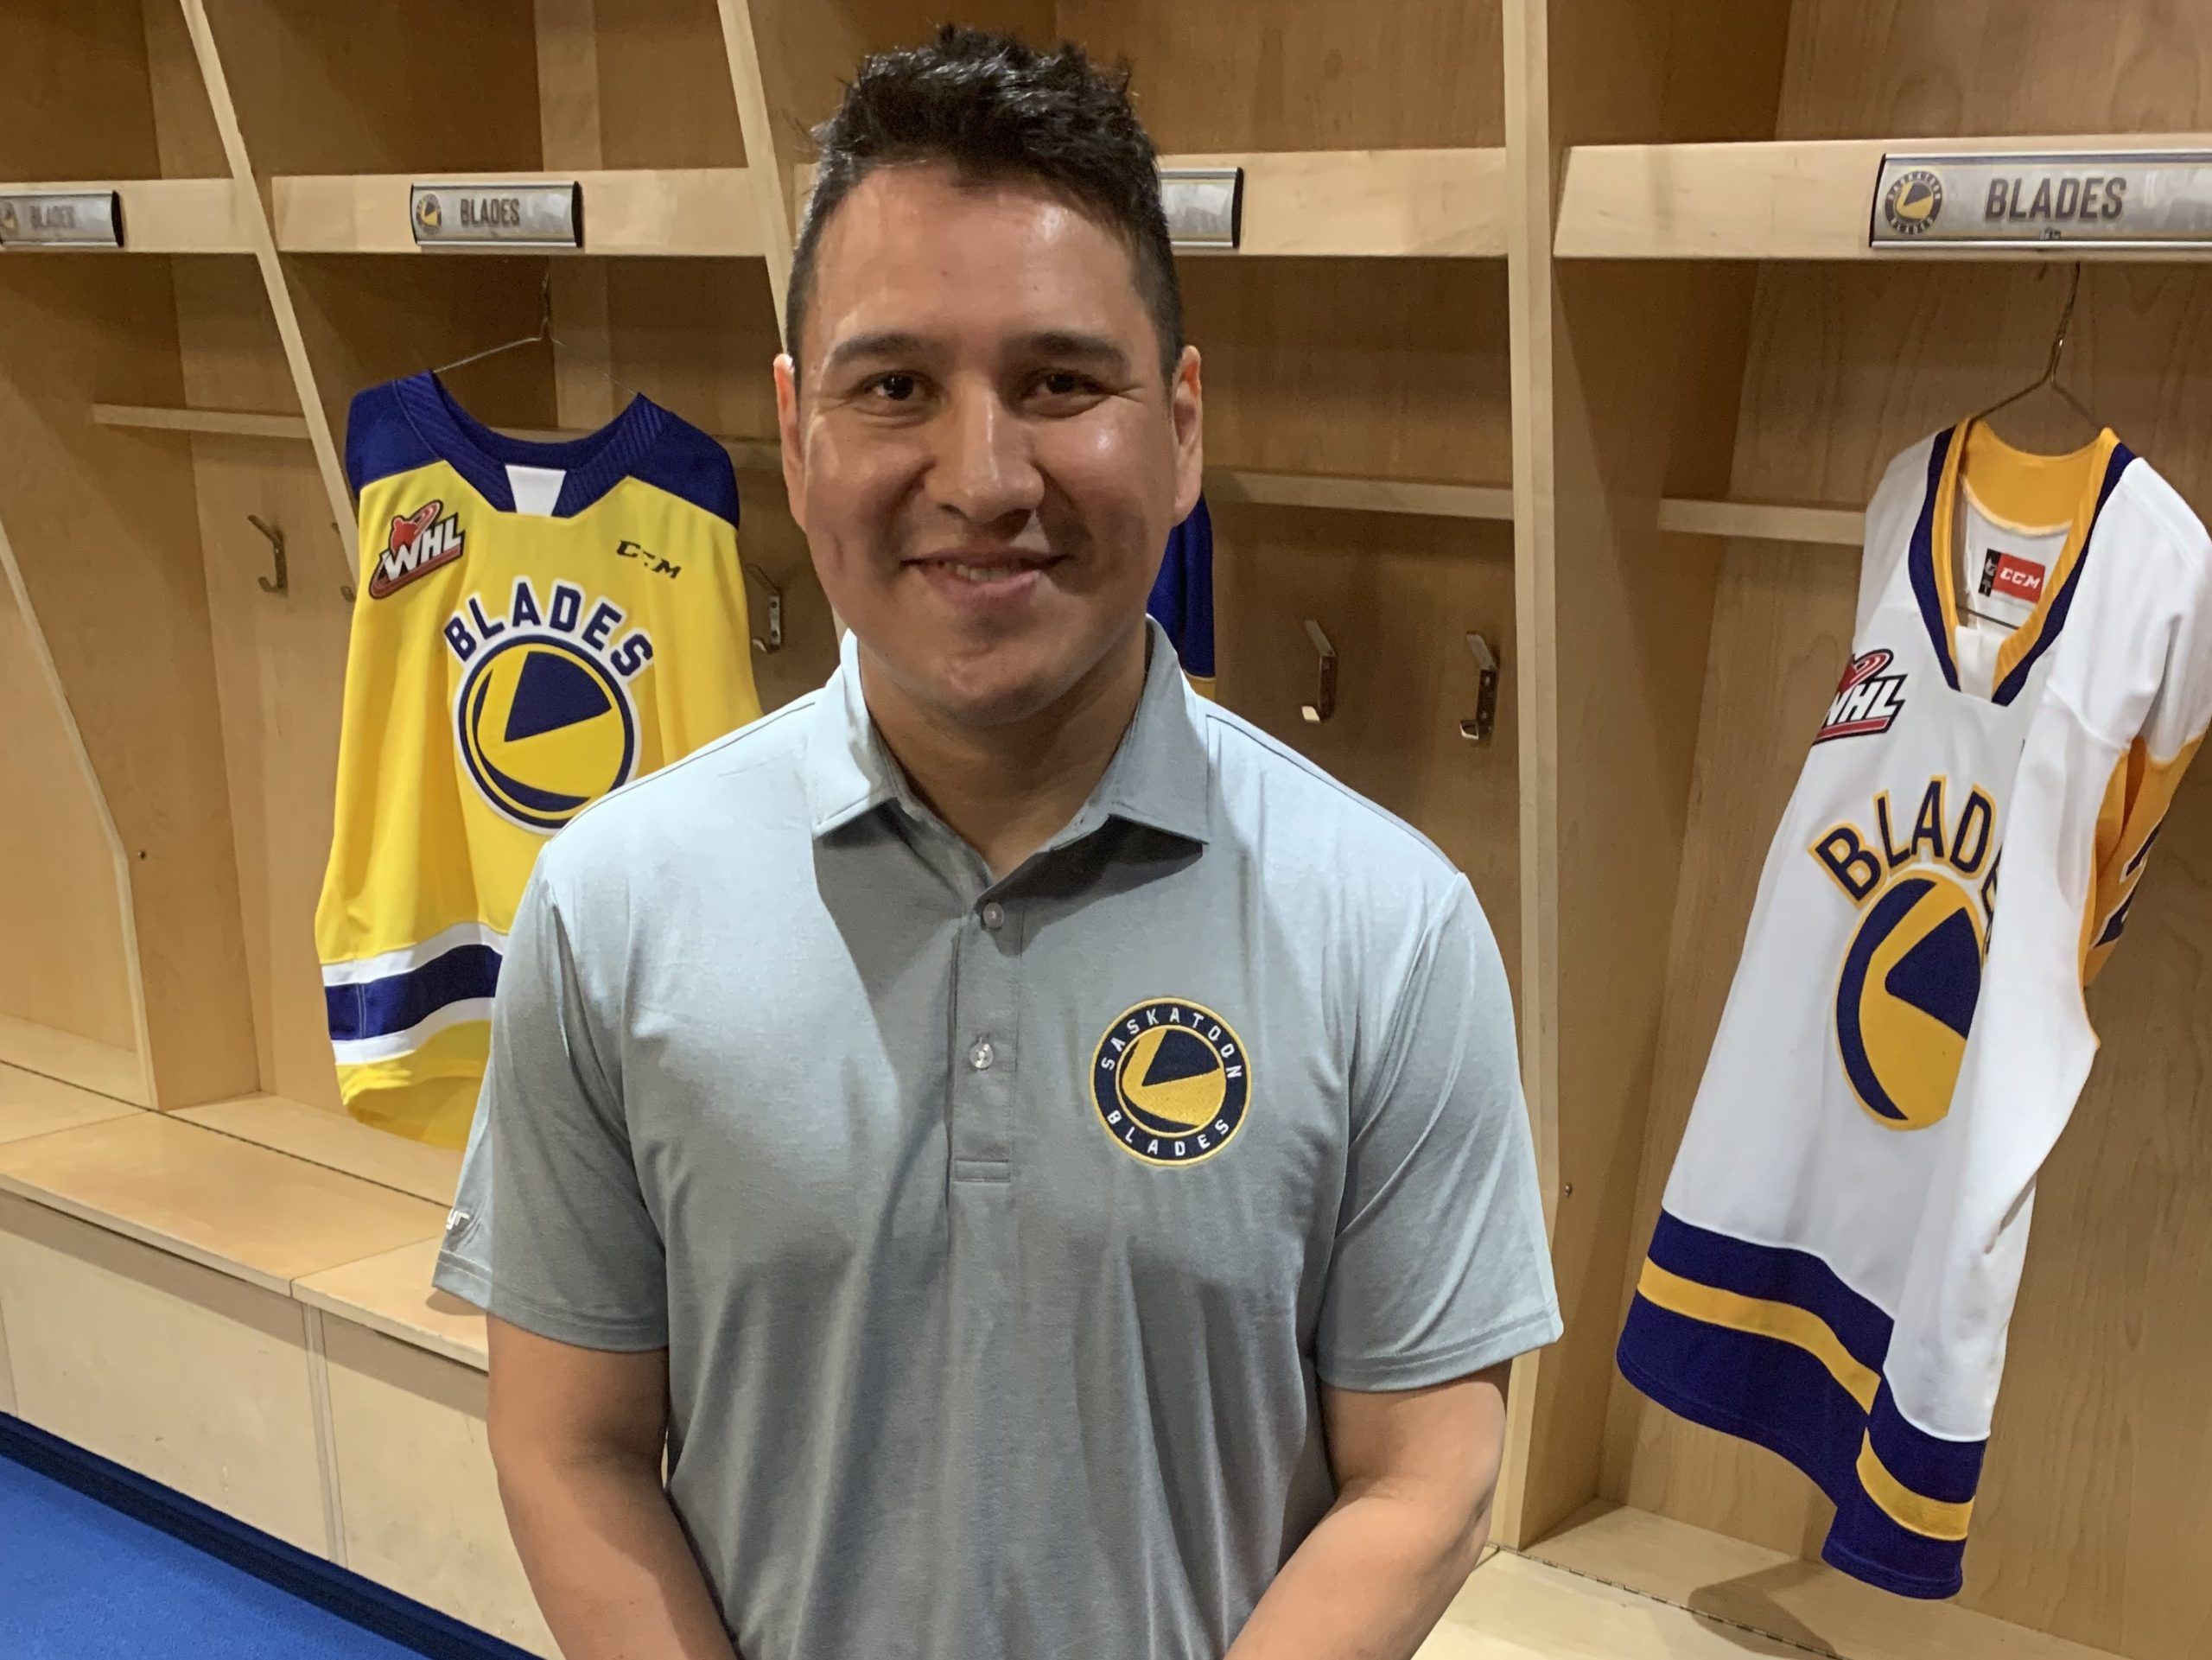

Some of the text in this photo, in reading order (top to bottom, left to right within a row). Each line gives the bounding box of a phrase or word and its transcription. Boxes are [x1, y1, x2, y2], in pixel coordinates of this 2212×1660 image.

[460, 198, 520, 226] BLADES
[1986, 176, 2127, 221] BLADES
[381, 516, 462, 582] WHL
[1999, 567, 2041, 589] CCM
[443, 582, 654, 677] BLADES
[1814, 779, 2003, 929] BLAD
[1102, 1008, 1243, 1078] SASKATOON
[1108, 1110, 1229, 1156] BLADES
